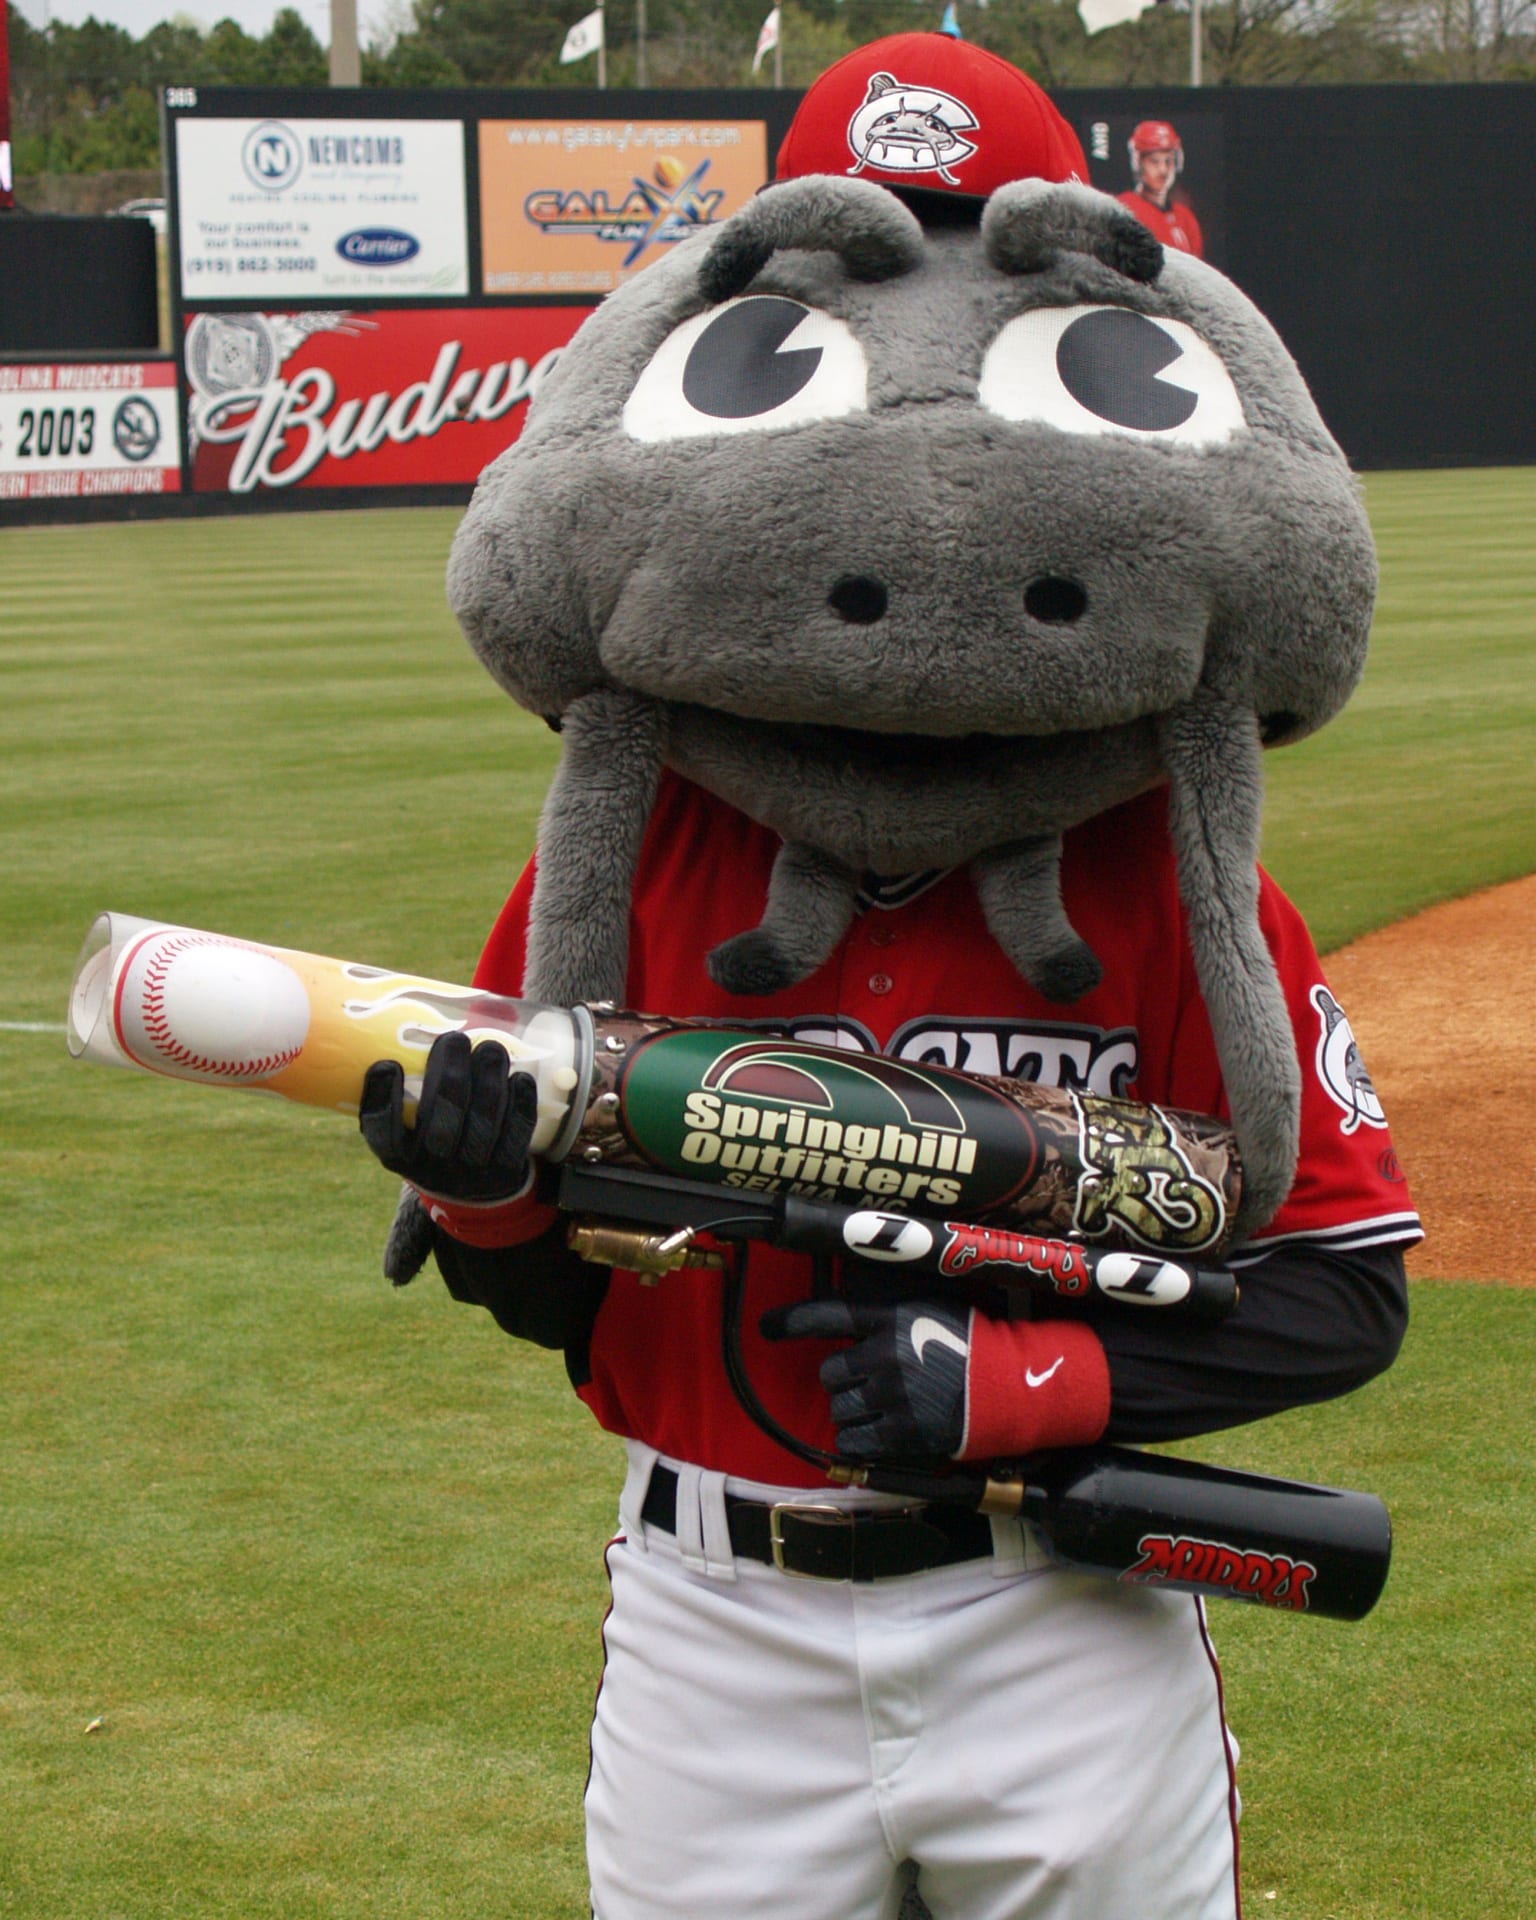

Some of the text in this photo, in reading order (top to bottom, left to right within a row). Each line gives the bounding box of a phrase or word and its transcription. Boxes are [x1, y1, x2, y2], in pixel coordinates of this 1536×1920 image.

[308, 136, 404, 165] NEWCOMB
[525, 175, 724, 240] GALAXY
[198, 221, 229, 234] Your
[235, 221, 292, 233] comfort
[204, 239, 228, 249] our
[344, 233, 411, 258] Carrier
[187, 257, 231, 274] (919)
[57, 364, 143, 388] MUDCATS
[17, 406, 95, 457] 2003
[82, 468, 163, 493] CHAMPIONS
[683, 1091, 978, 1175] Springhill
[680, 1131, 962, 1206] Outfitters
[939, 1221, 1091, 1296] MUDDY
[1118, 1533, 1317, 1610] MUDDY
